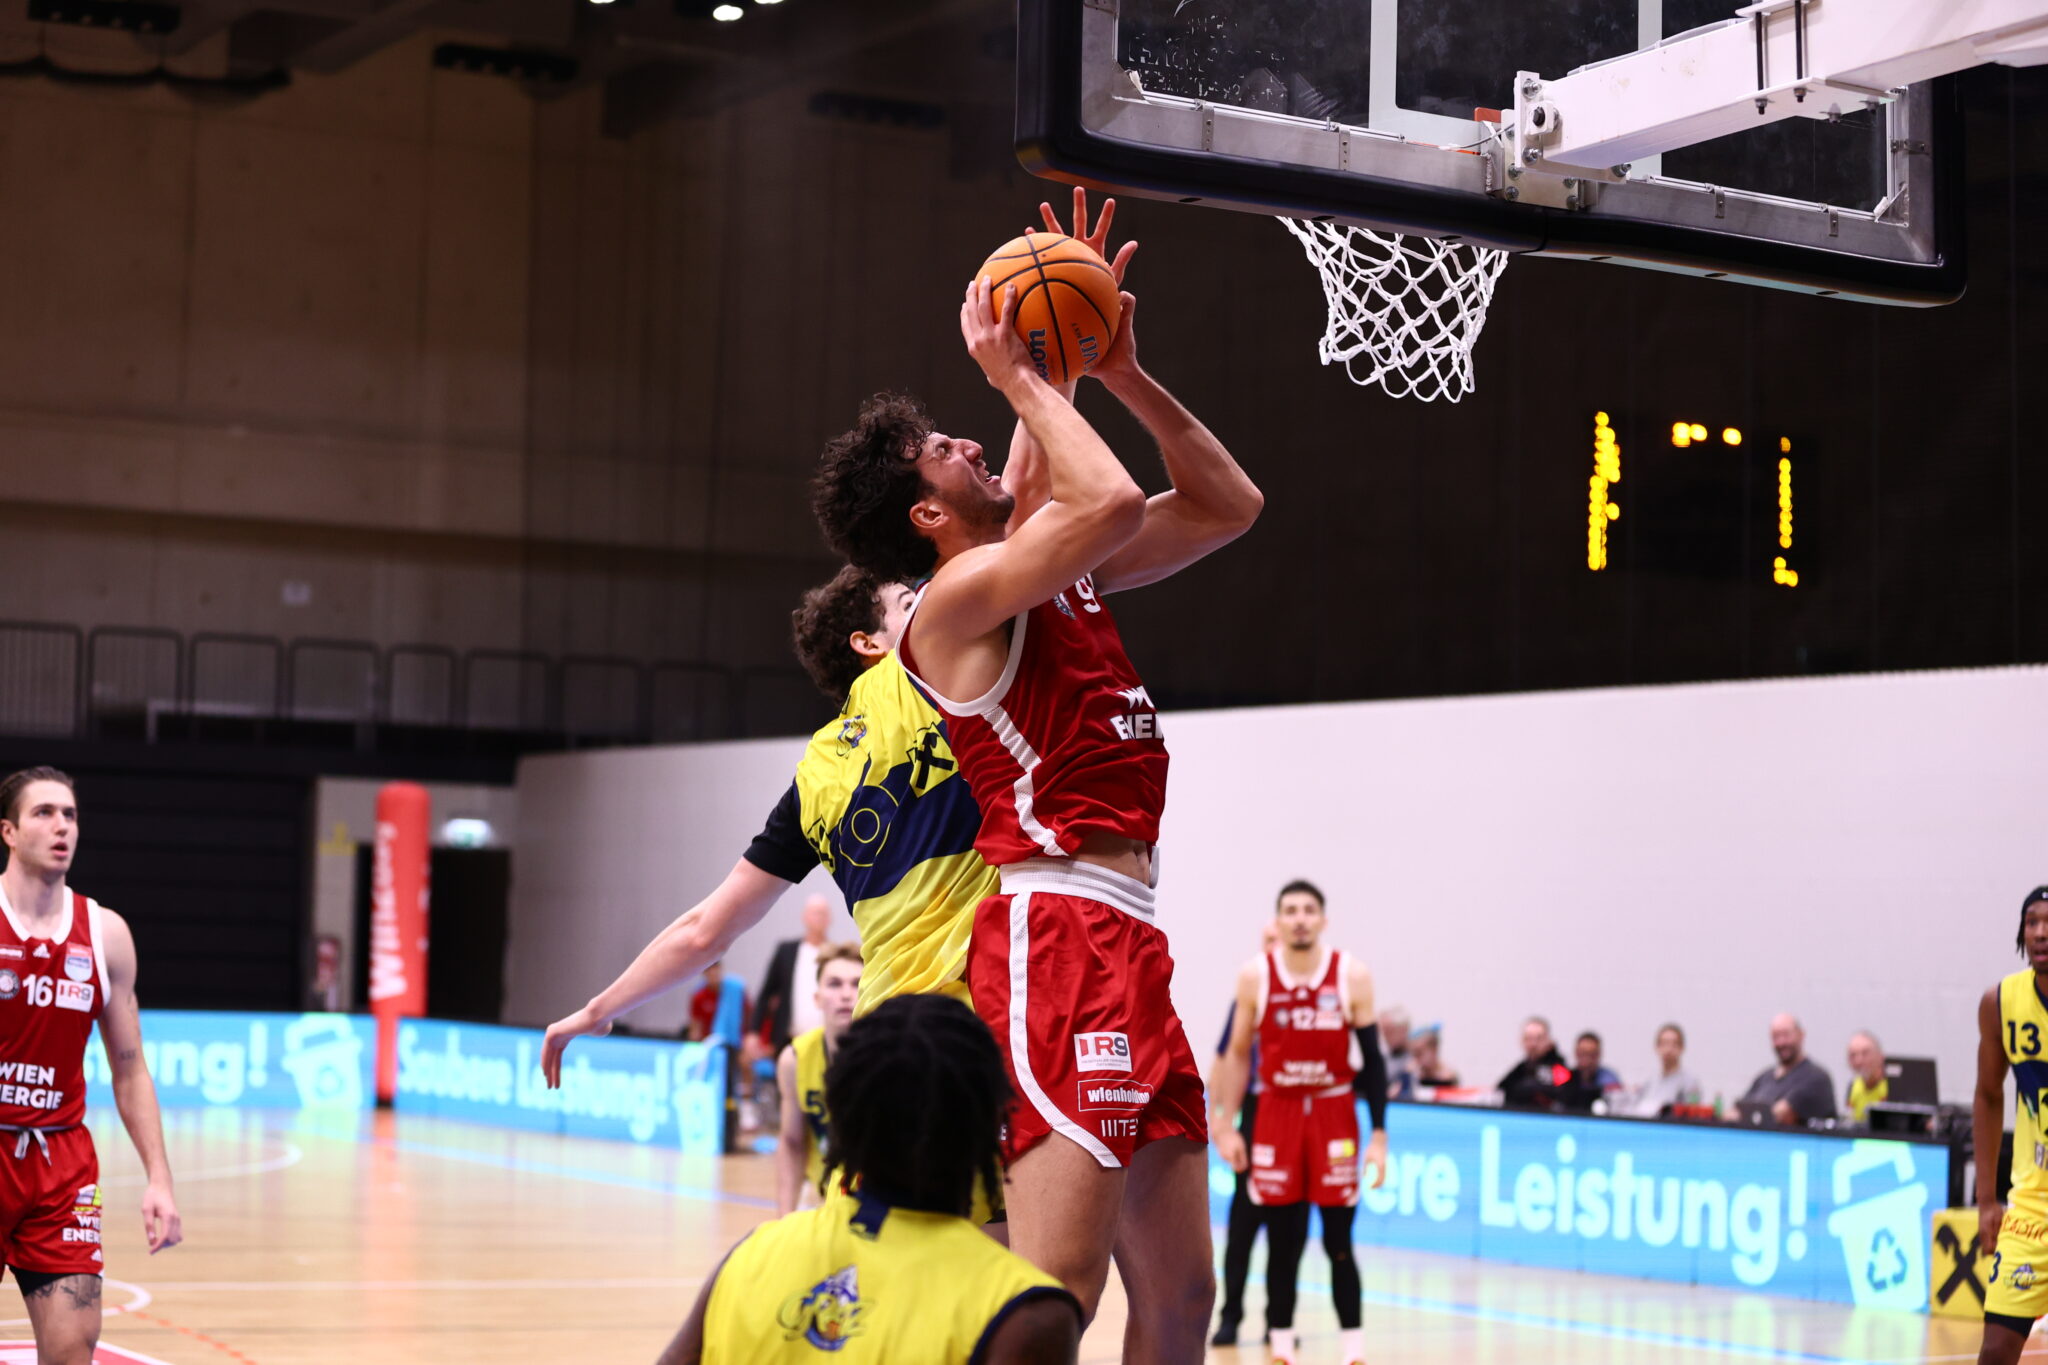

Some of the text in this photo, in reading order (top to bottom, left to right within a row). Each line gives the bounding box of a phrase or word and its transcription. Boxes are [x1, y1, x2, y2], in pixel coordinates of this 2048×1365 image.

[22, 973, 54, 1007] 16
[2007, 1020, 2042, 1056] 13
[0, 1083, 63, 1110] ERGIE
[1479, 1124, 1809, 1286] Leistung!
